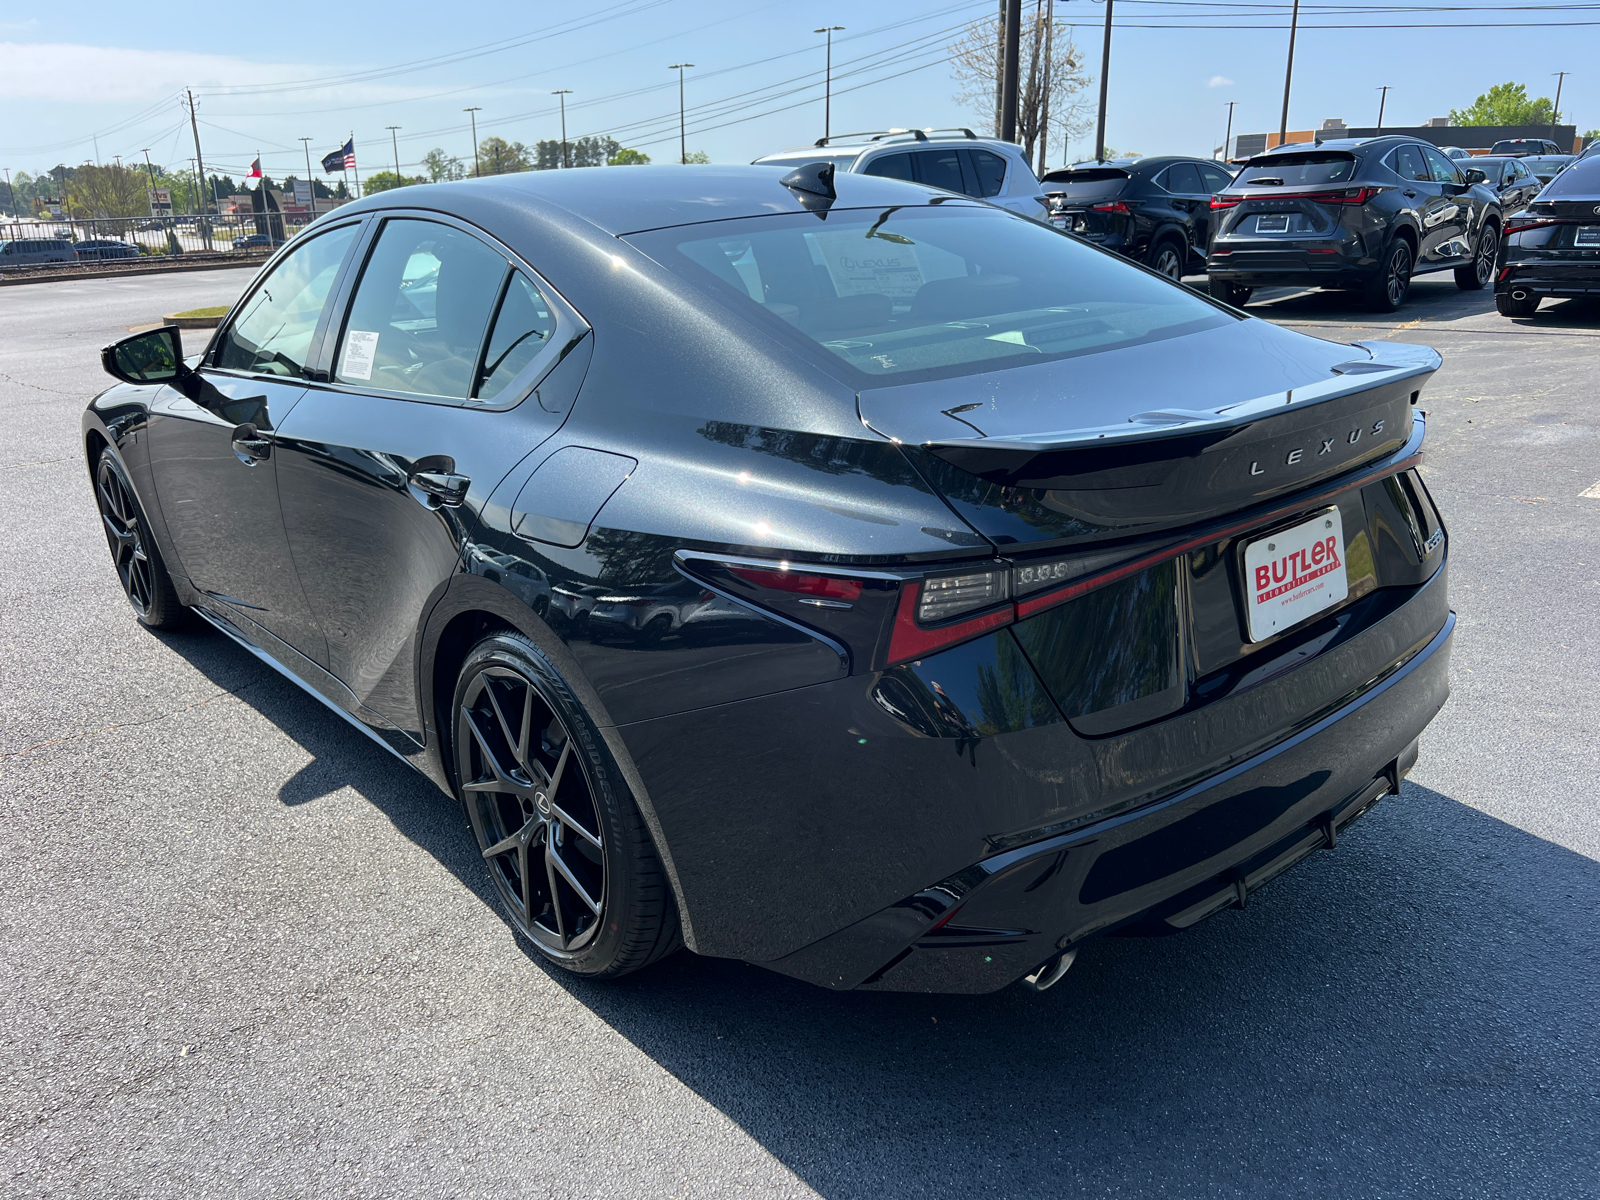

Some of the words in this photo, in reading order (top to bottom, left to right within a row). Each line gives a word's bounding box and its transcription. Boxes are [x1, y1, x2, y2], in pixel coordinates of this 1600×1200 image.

[855, 258, 901, 268] LEXUS
[1249, 419, 1385, 476] LEXUS
[1316, 561, 1339, 577] GROUP
[1281, 582, 1324, 606] www.butlercars.com
